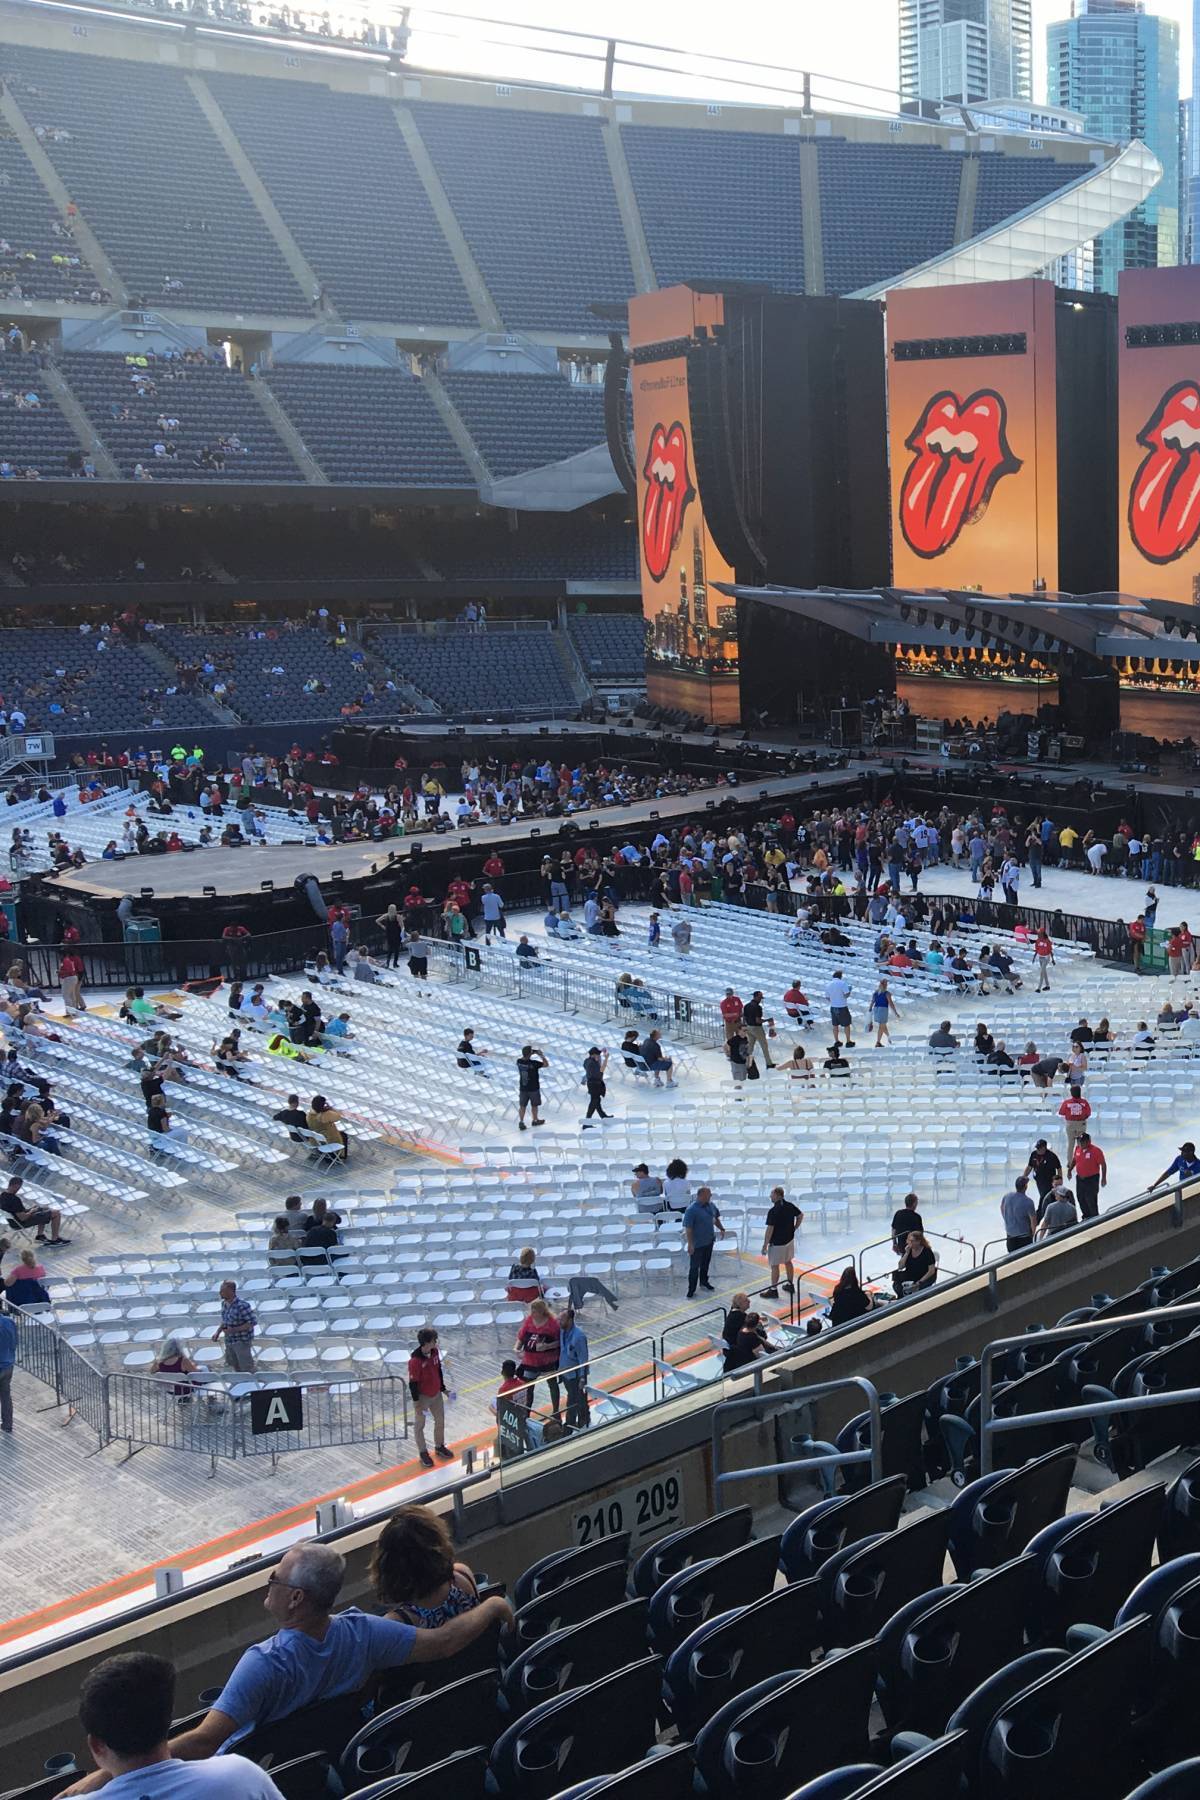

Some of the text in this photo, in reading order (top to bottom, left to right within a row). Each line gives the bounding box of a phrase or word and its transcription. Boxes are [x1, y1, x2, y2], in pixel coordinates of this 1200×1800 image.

[468, 951, 477, 967] B
[264, 1397, 290, 1426] A
[502, 1410, 519, 1431] ADA
[500, 1424, 520, 1447] EAST
[576, 1477, 680, 1547] 210 209
